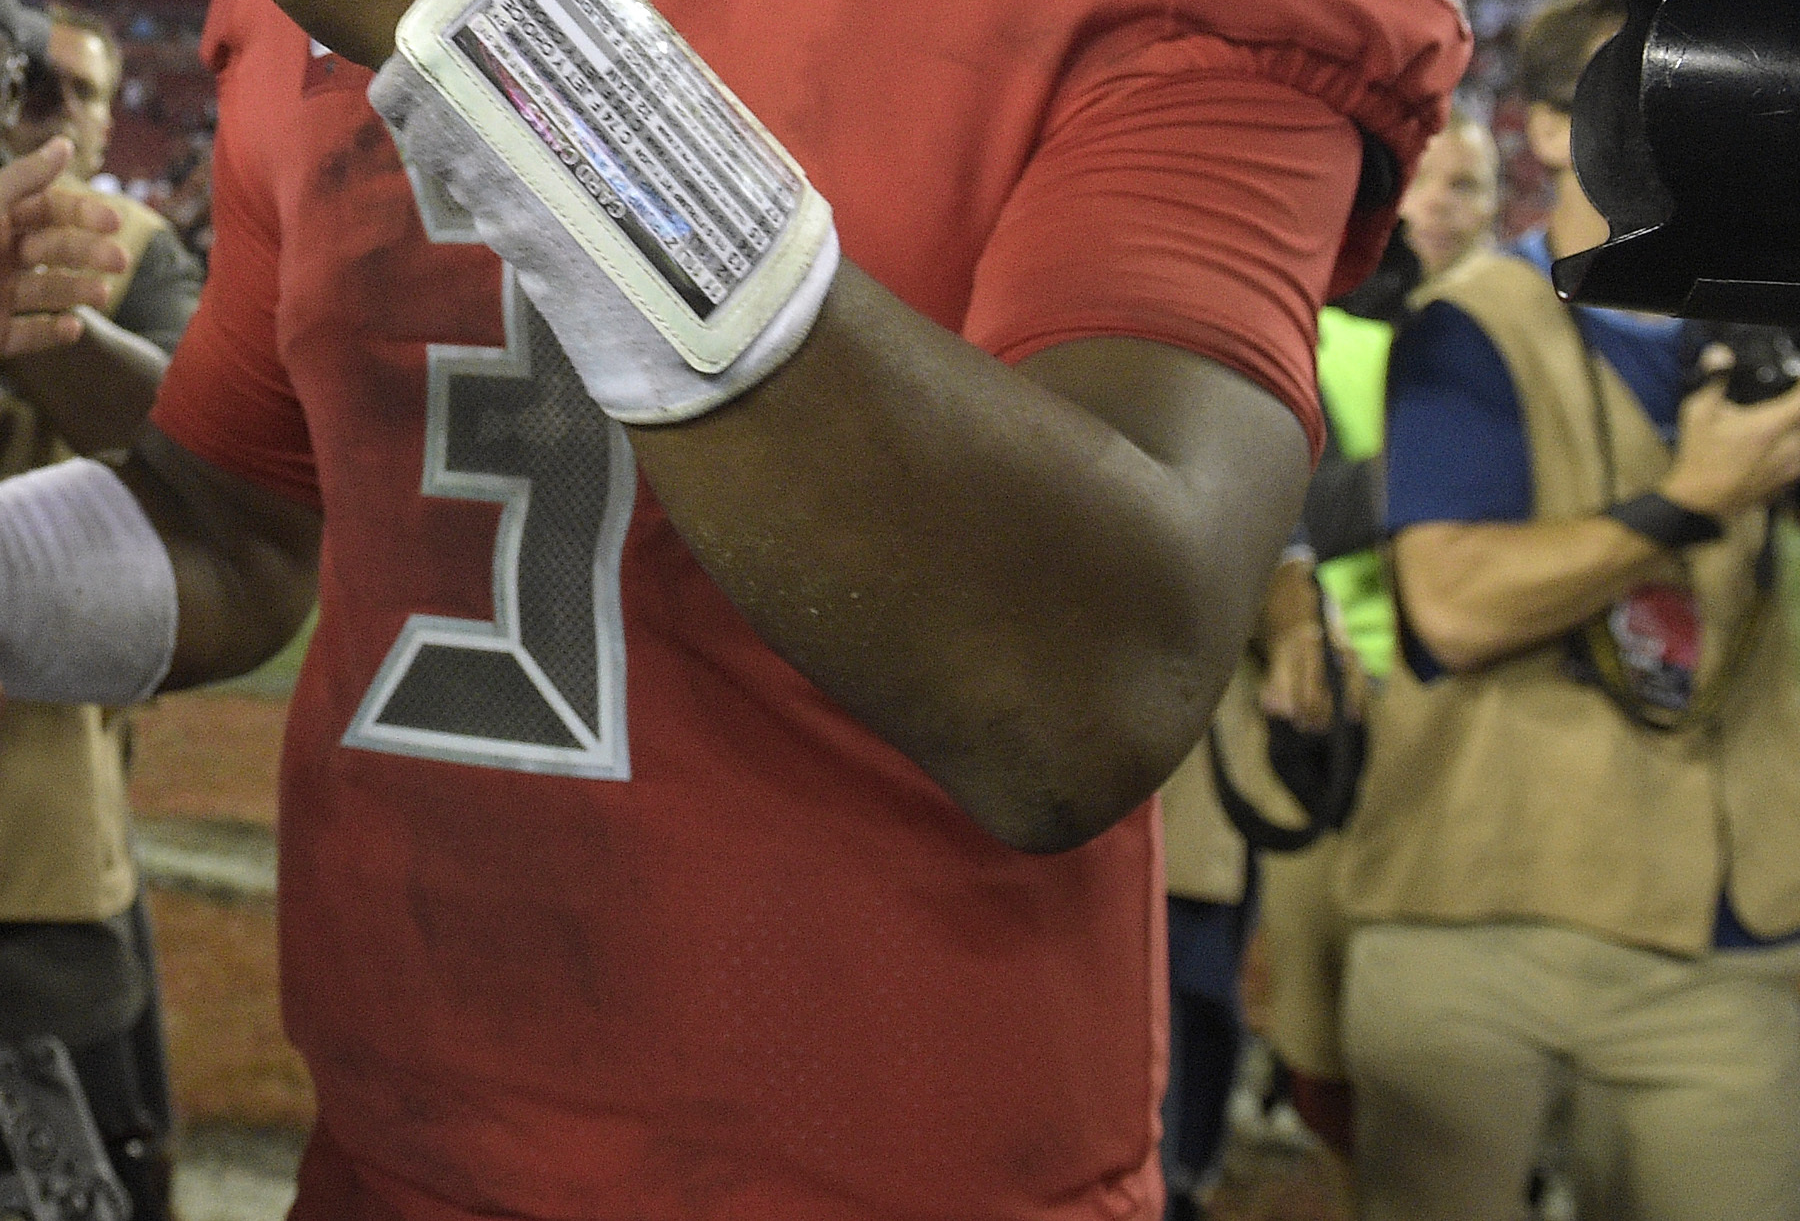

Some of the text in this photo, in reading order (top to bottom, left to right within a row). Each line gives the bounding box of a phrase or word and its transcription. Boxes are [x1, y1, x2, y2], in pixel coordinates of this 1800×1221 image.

[519, 98, 627, 221] CARD CALLS
[341, 119, 632, 783] 3
